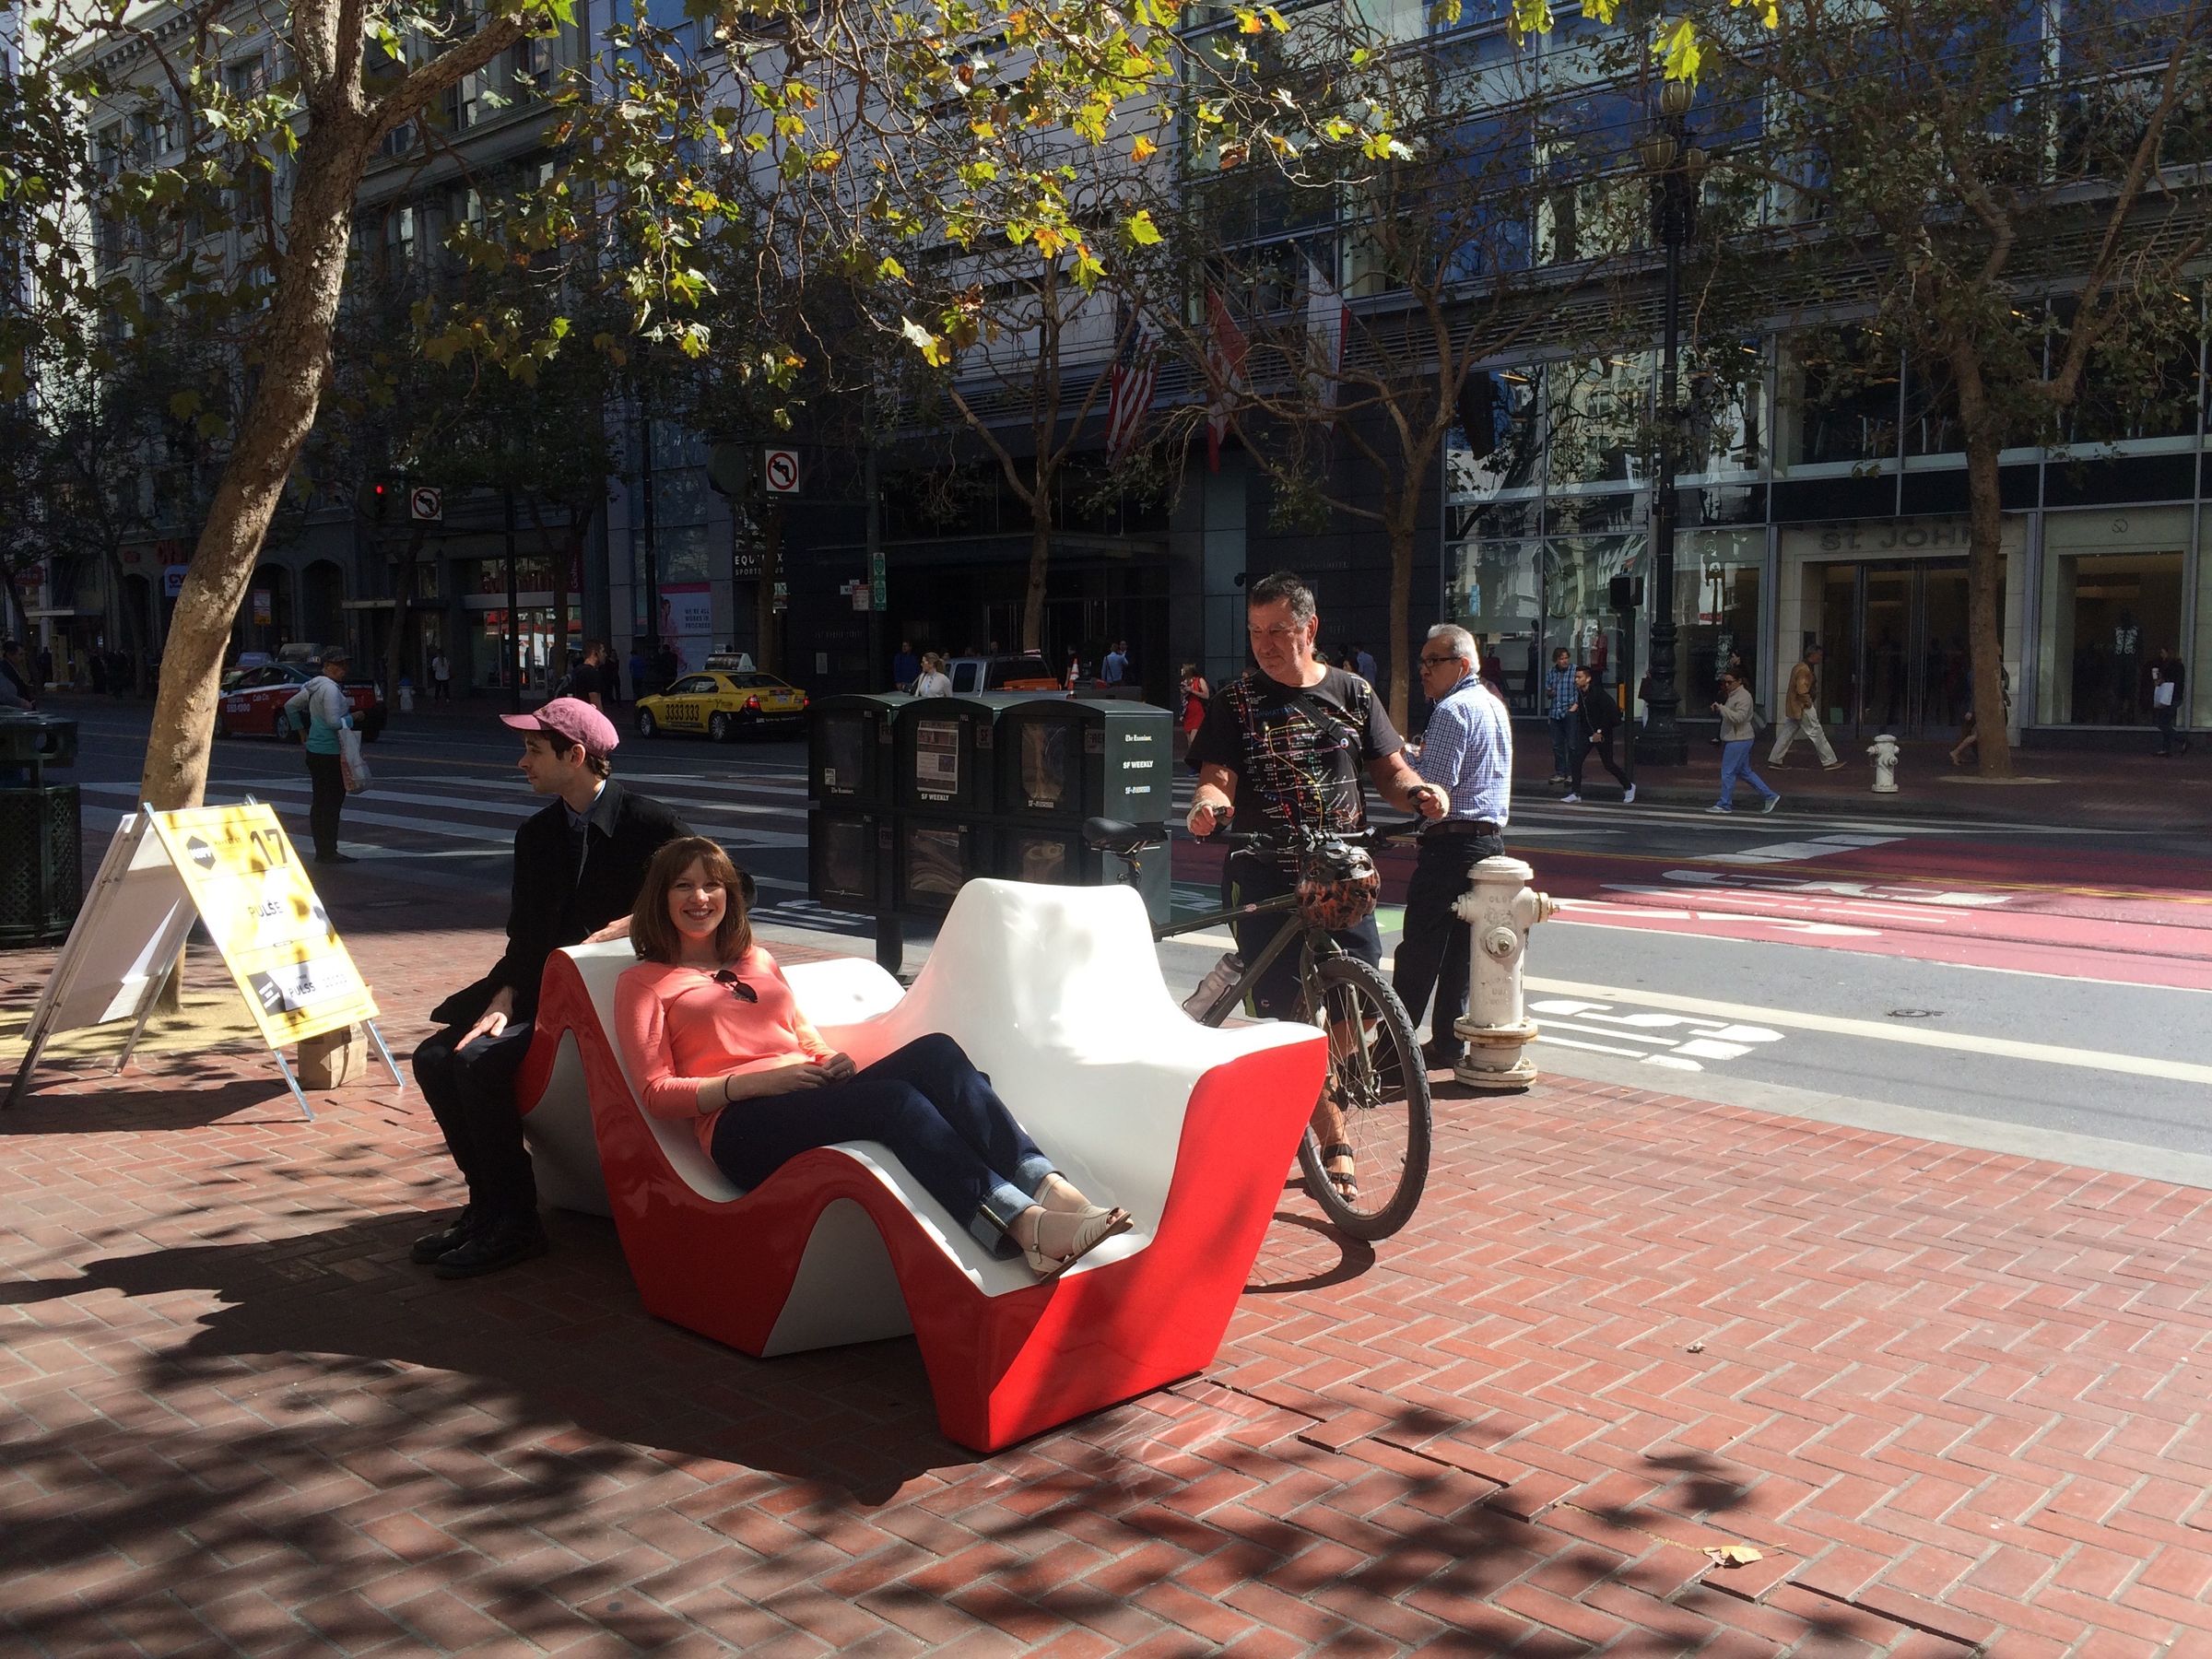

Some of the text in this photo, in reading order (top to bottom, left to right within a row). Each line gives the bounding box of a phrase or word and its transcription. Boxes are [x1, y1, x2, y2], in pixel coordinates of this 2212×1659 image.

[735, 553, 783, 567] EQUX
[1123, 760, 1154, 770] SF WEEKLY
[922, 793, 950, 803] SF WEEKLY
[250, 829, 288, 865] 17
